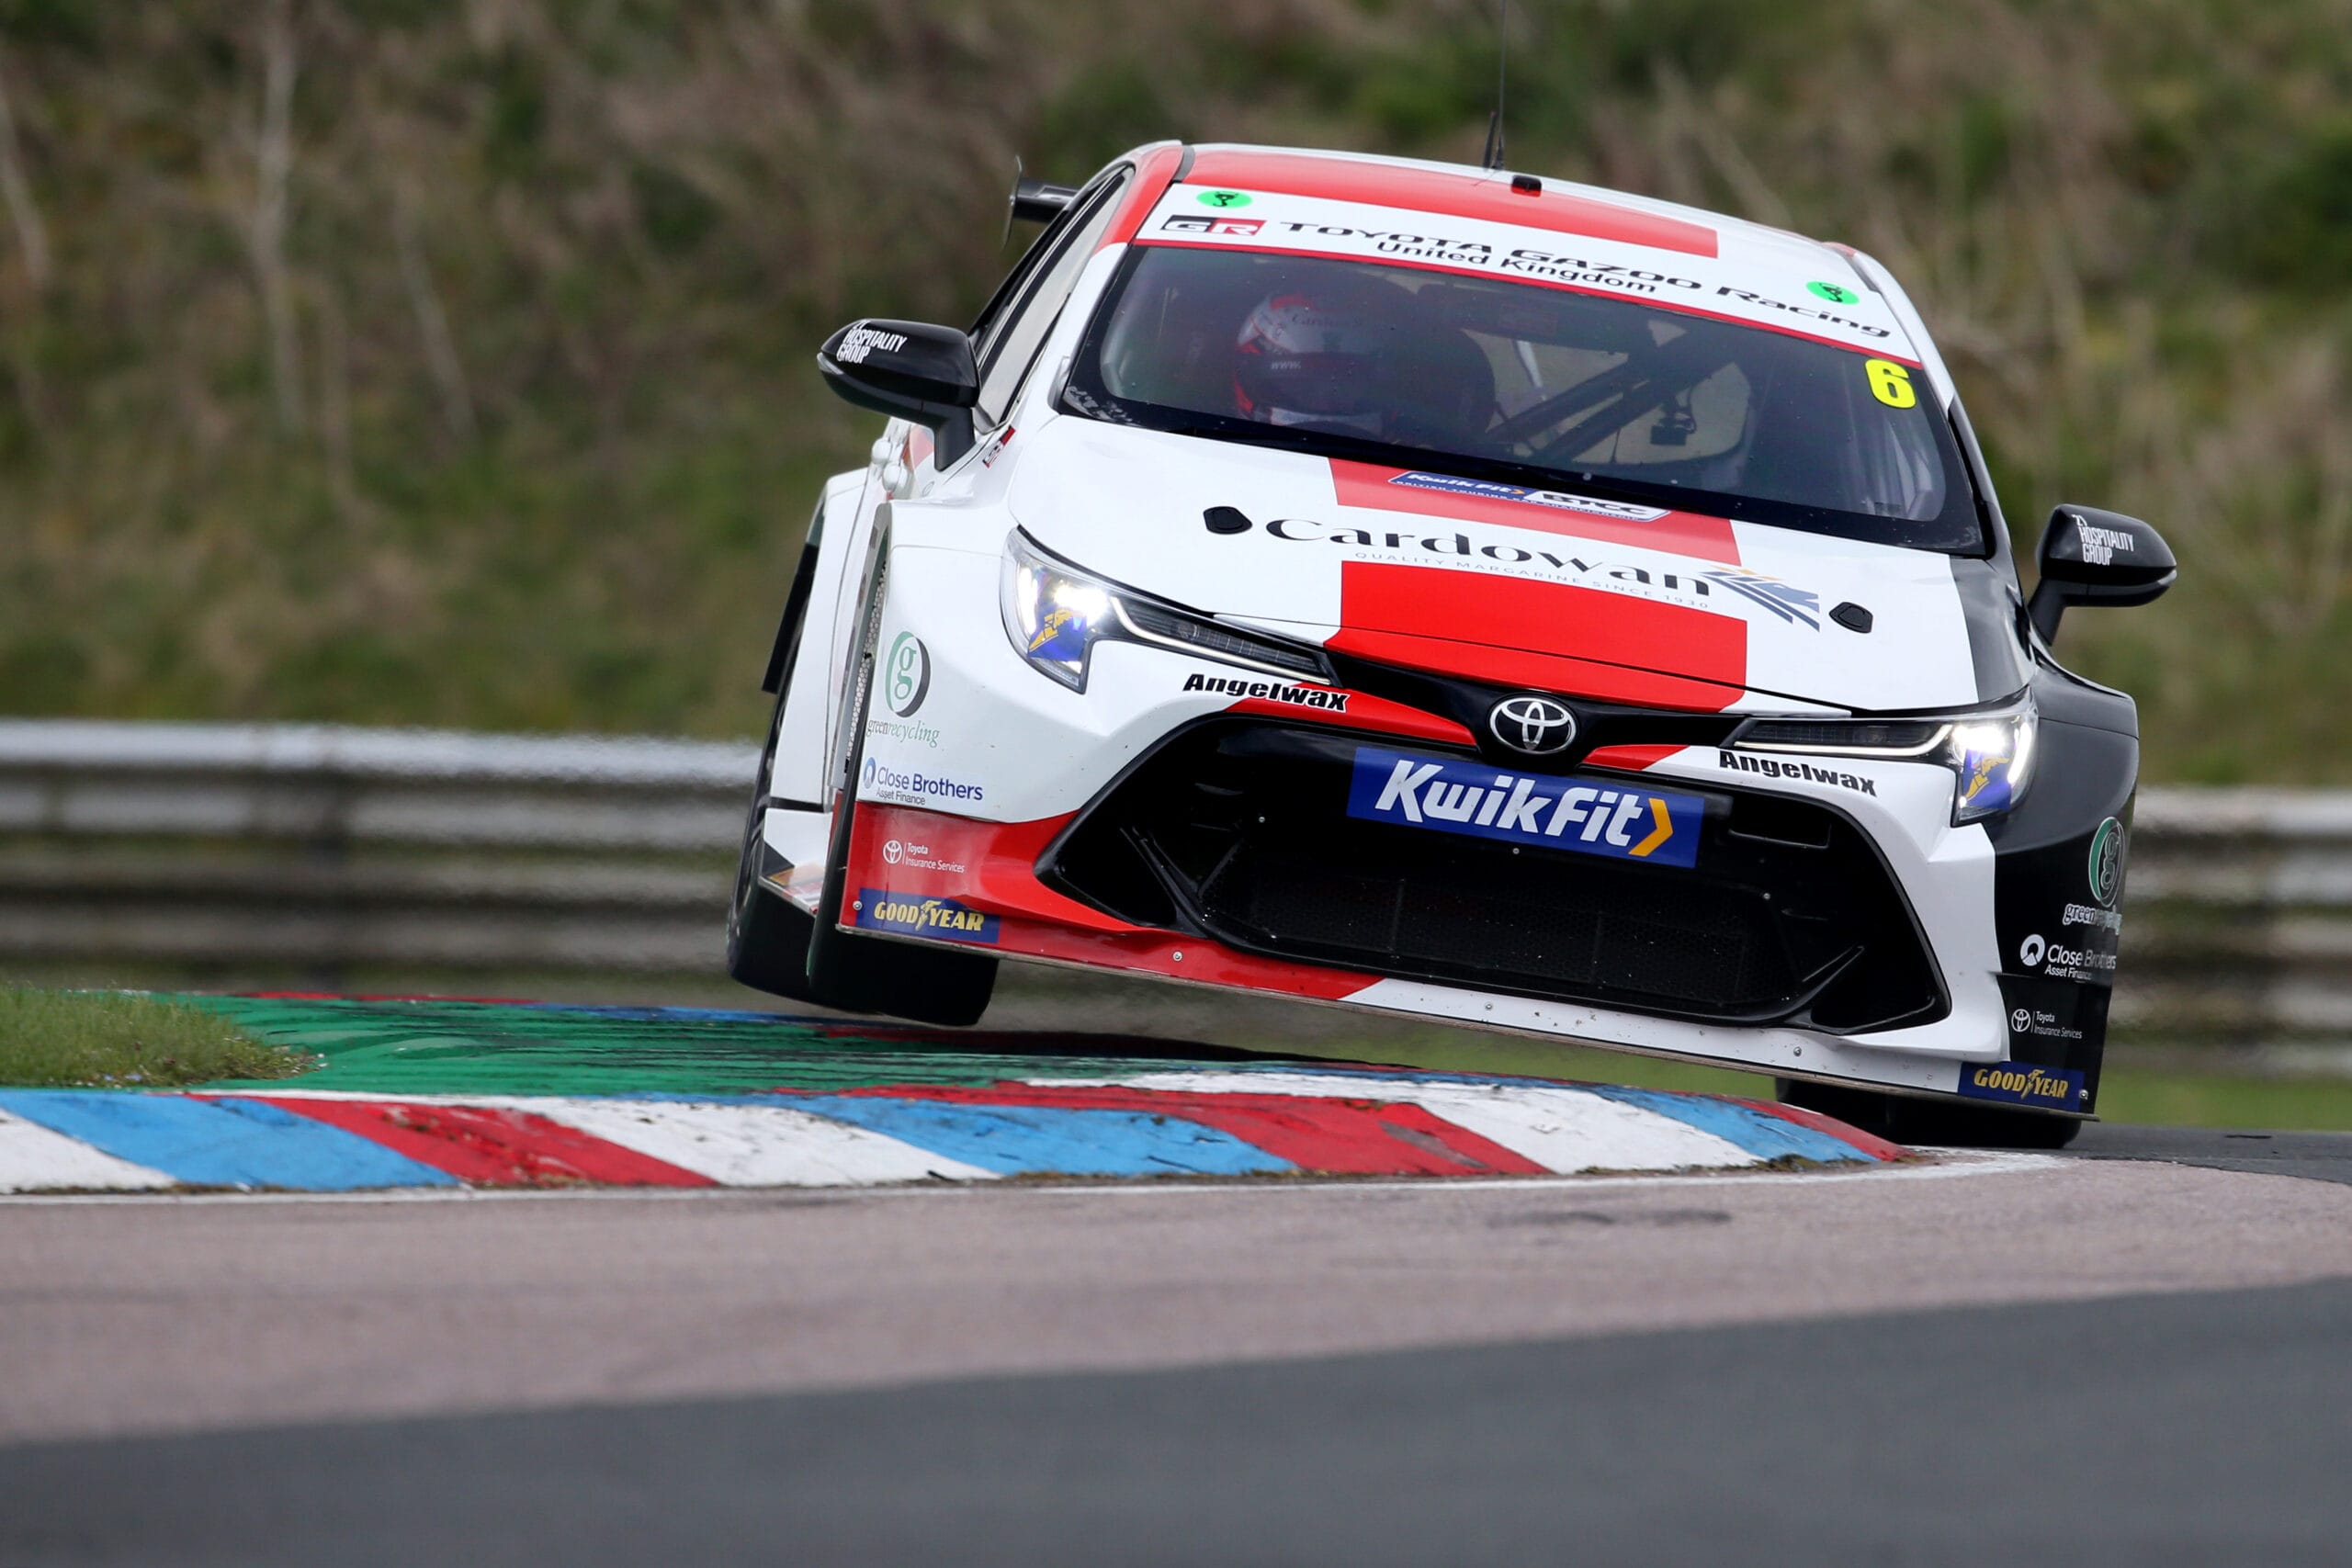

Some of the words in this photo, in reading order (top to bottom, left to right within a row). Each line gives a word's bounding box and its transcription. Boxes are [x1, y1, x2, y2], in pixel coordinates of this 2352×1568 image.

[1160, 216, 1264, 235] GR
[1377, 242, 1490, 265] United
[1500, 258, 1657, 292] Kingdom
[1280, 221, 1492, 253] TOYOTA
[1510, 249, 1702, 290] GAZOO
[1716, 286, 1892, 338] Racing
[842, 329, 908, 353] HOSPITALITY
[836, 344, 871, 365] GROUP
[1865, 358, 1917, 410] 6
[1543, 493, 1647, 515] BTCC
[2078, 526, 2134, 552] HOSPITALITY
[1266, 519, 1710, 597] Cardowan
[2082, 543, 2113, 566] GROUP
[1355, 552, 1445, 566] QUALITY
[1456, 561, 1582, 584] MARGARINE
[1592, 581, 1653, 597] SINCE
[1663, 594, 1709, 609] 1930
[1182, 673, 1349, 712] Angelwax
[877, 766, 910, 790] Close
[912, 773, 983, 801] Brothers
[1719, 750, 1877, 797] Angelwax
[876, 787, 896, 801] Asset
[896, 791, 926, 806] Finance
[907, 842, 929, 856] Toyota
[905, 856, 937, 870] Insurance
[937, 861, 966, 874] Services
[2047, 943, 2084, 966] Close
[2044, 964, 2067, 977] Asset
[2036, 1010, 2055, 1023] Toyota
[2033, 1023, 2061, 1037] Insurance
[2061, 1028, 2083, 1040] Services
